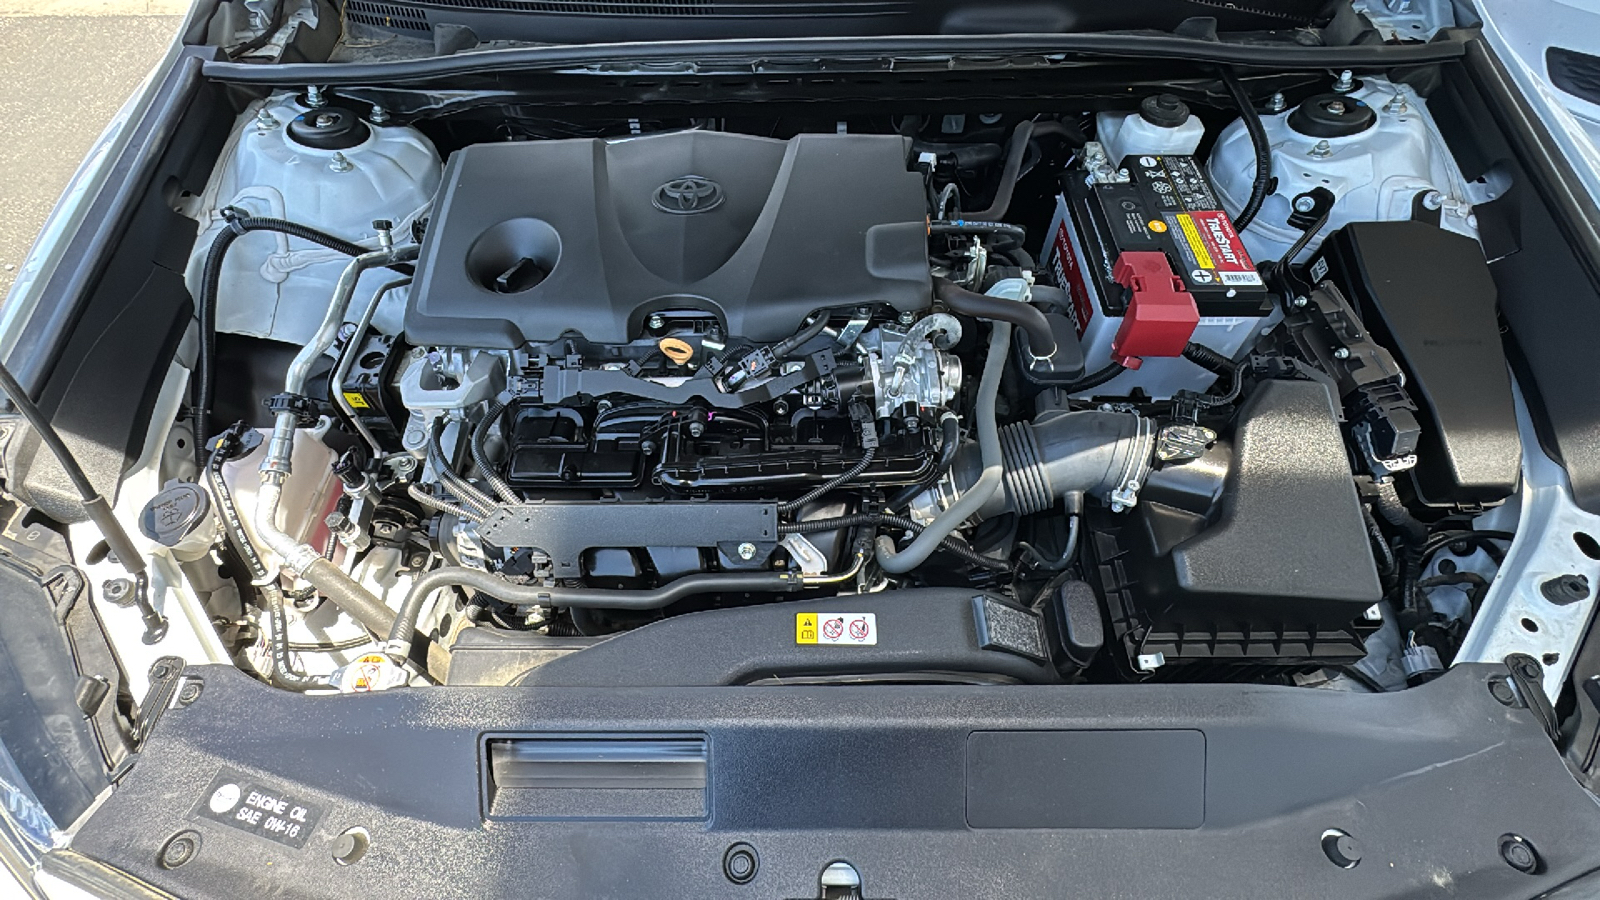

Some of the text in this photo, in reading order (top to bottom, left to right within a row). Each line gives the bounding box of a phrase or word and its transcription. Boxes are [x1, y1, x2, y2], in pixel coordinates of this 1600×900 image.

[1205, 217, 1239, 265] TRUESTART
[1221, 219, 1234, 238] TOYOTA
[245, 791, 288, 815] ENGINE
[289, 806, 308, 822] OIL
[236, 807, 300, 838] SAE 0W-16
